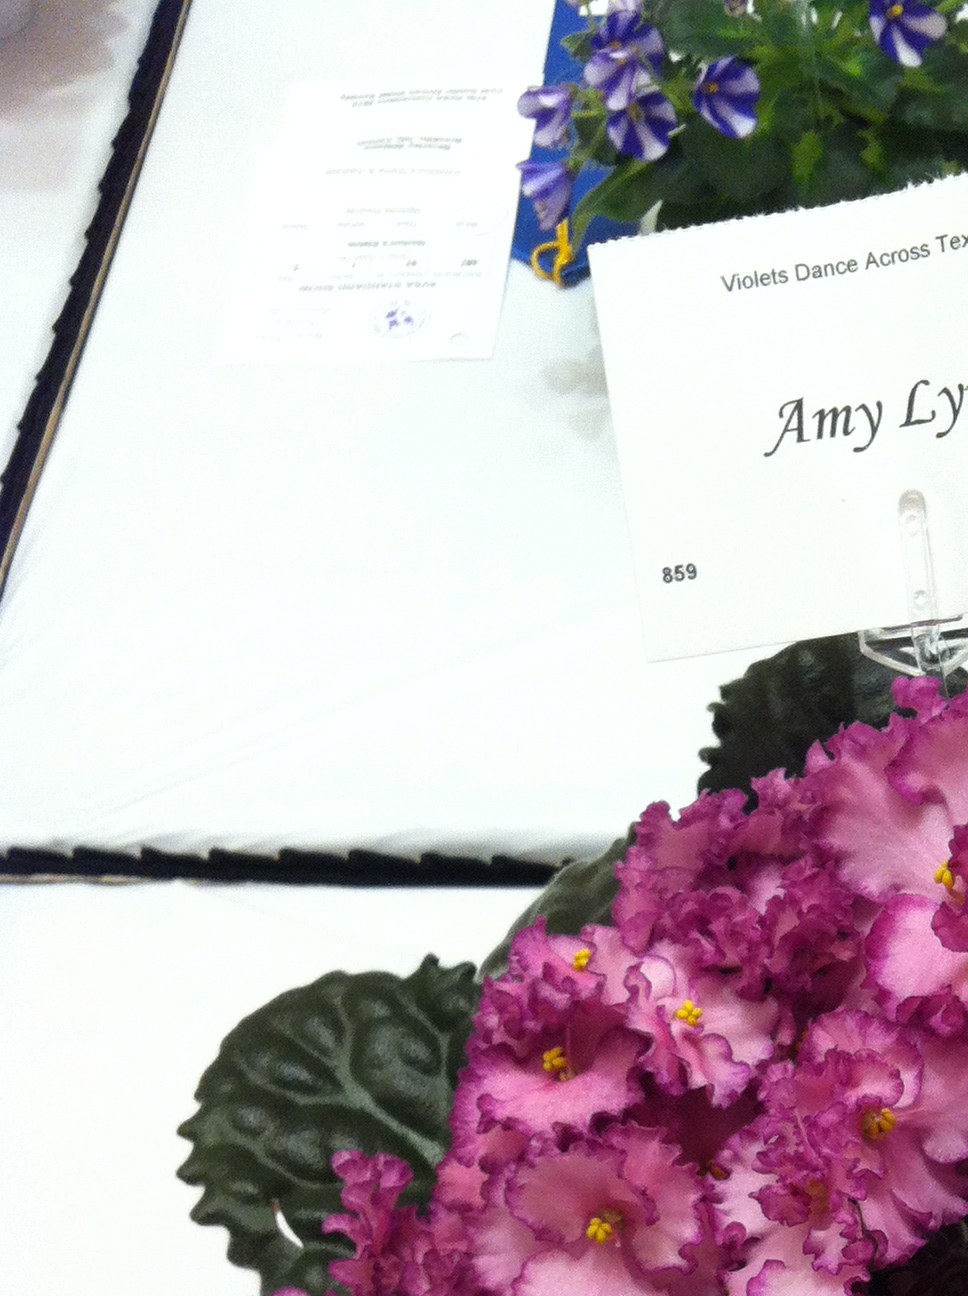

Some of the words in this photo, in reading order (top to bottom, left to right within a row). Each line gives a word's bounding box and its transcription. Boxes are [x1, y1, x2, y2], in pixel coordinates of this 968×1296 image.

[721, 268, 789, 292] Violets
[794, 258, 859, 282] Dance
[865, 243, 931, 270] Across
[763, 397, 883, 458] Amy
[661, 563, 698, 584] 859
